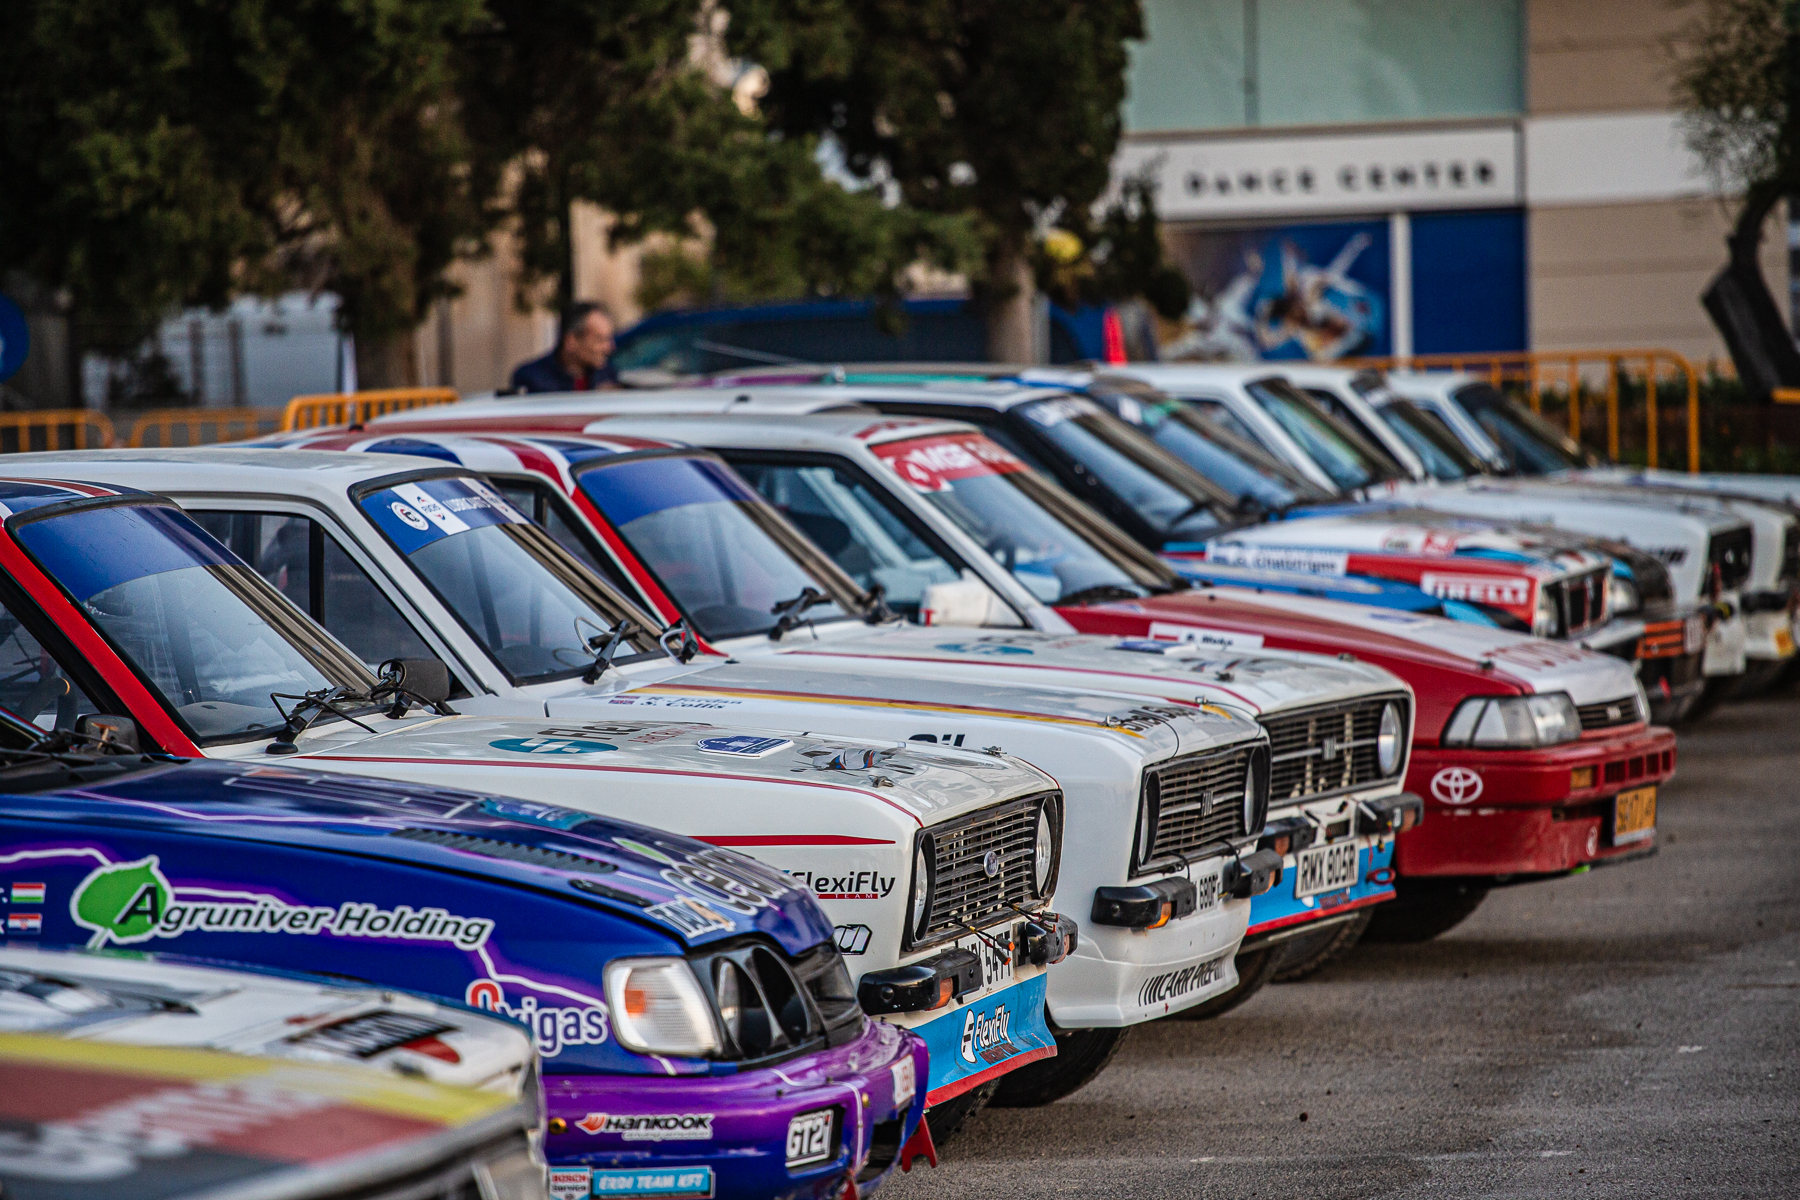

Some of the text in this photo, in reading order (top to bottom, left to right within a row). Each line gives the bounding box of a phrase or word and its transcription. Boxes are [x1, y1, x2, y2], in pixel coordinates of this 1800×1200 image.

[1183, 159, 1497, 197] DANCE CENTER
[1420, 571, 1530, 605] PIRELLI
[114, 885, 487, 944] Agruniver Holding
[471, 983, 603, 1053] Oigas
[974, 1003, 1015, 1052] FlexiFly
